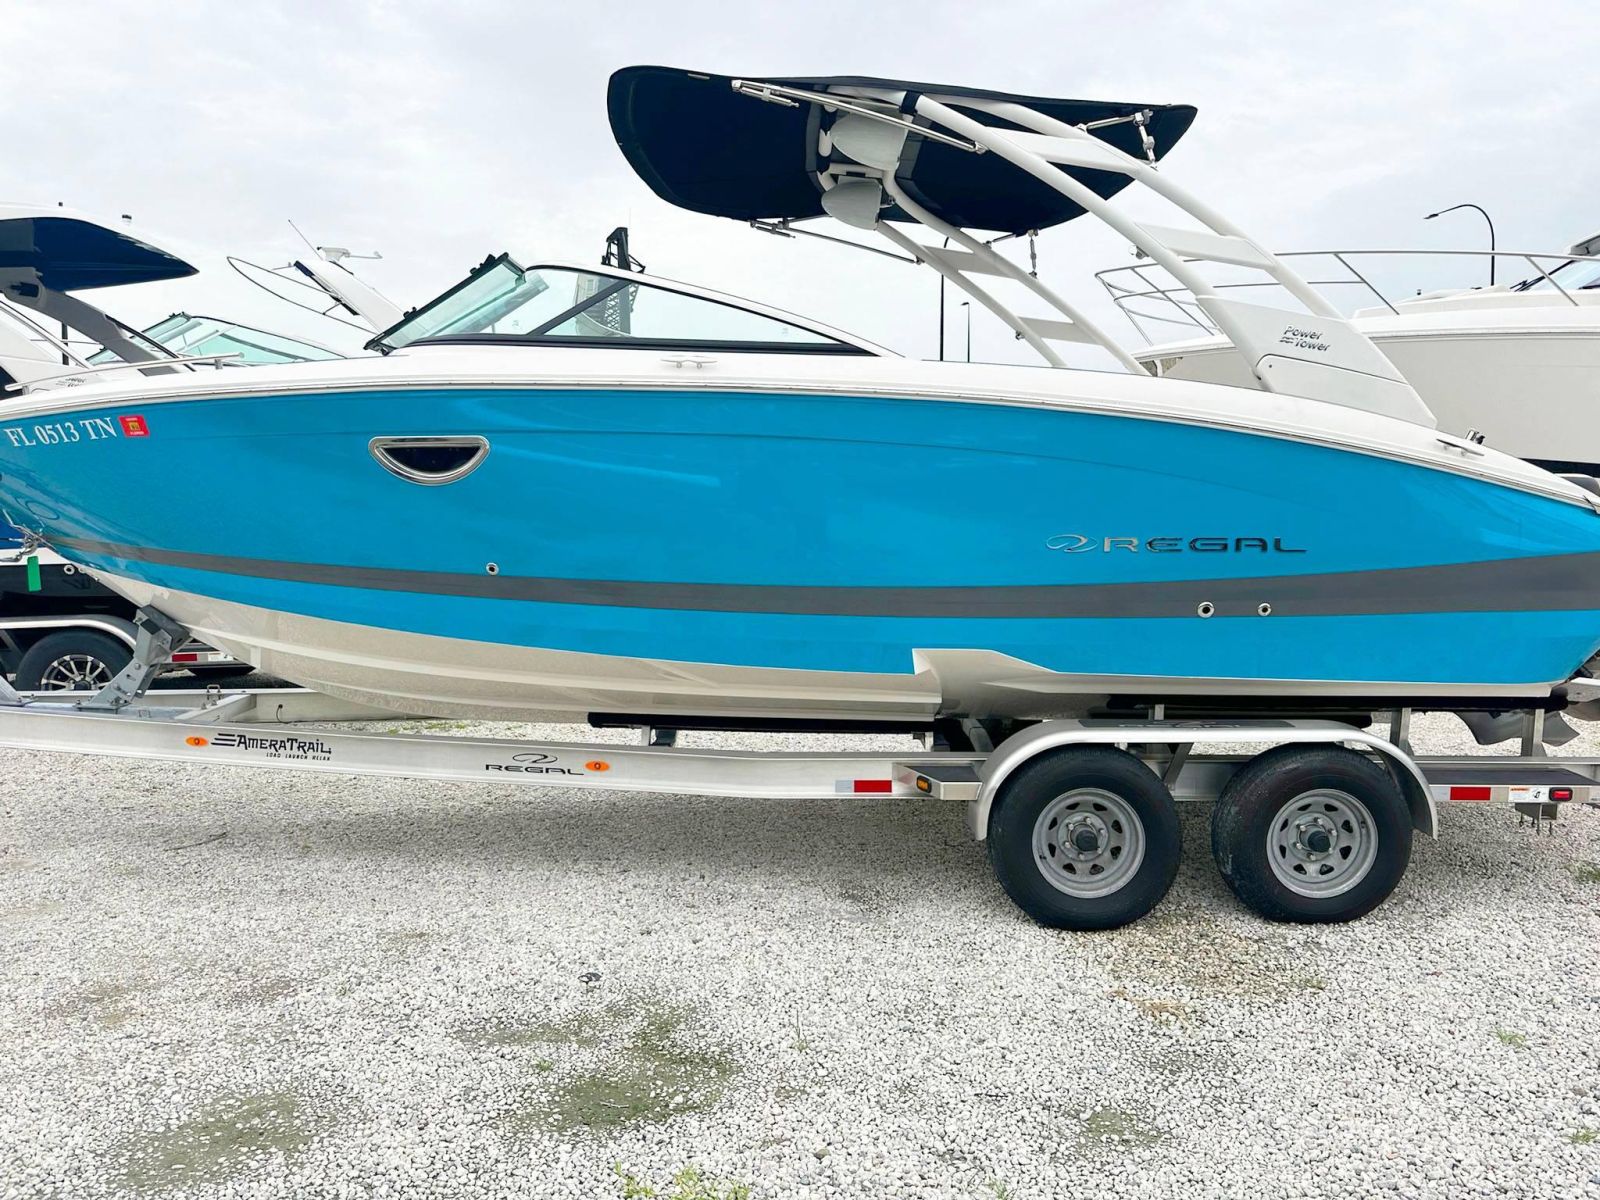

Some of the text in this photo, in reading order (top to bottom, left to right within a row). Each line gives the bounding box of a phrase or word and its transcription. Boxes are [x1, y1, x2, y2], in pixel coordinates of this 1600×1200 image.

[1284, 326, 1323, 340] Power
[1295, 338, 1331, 351] Tower
[3, 417, 117, 447] FL 0513 TN
[1103, 536, 1307, 553] REGAL
[485, 763, 584, 776] REGAL
